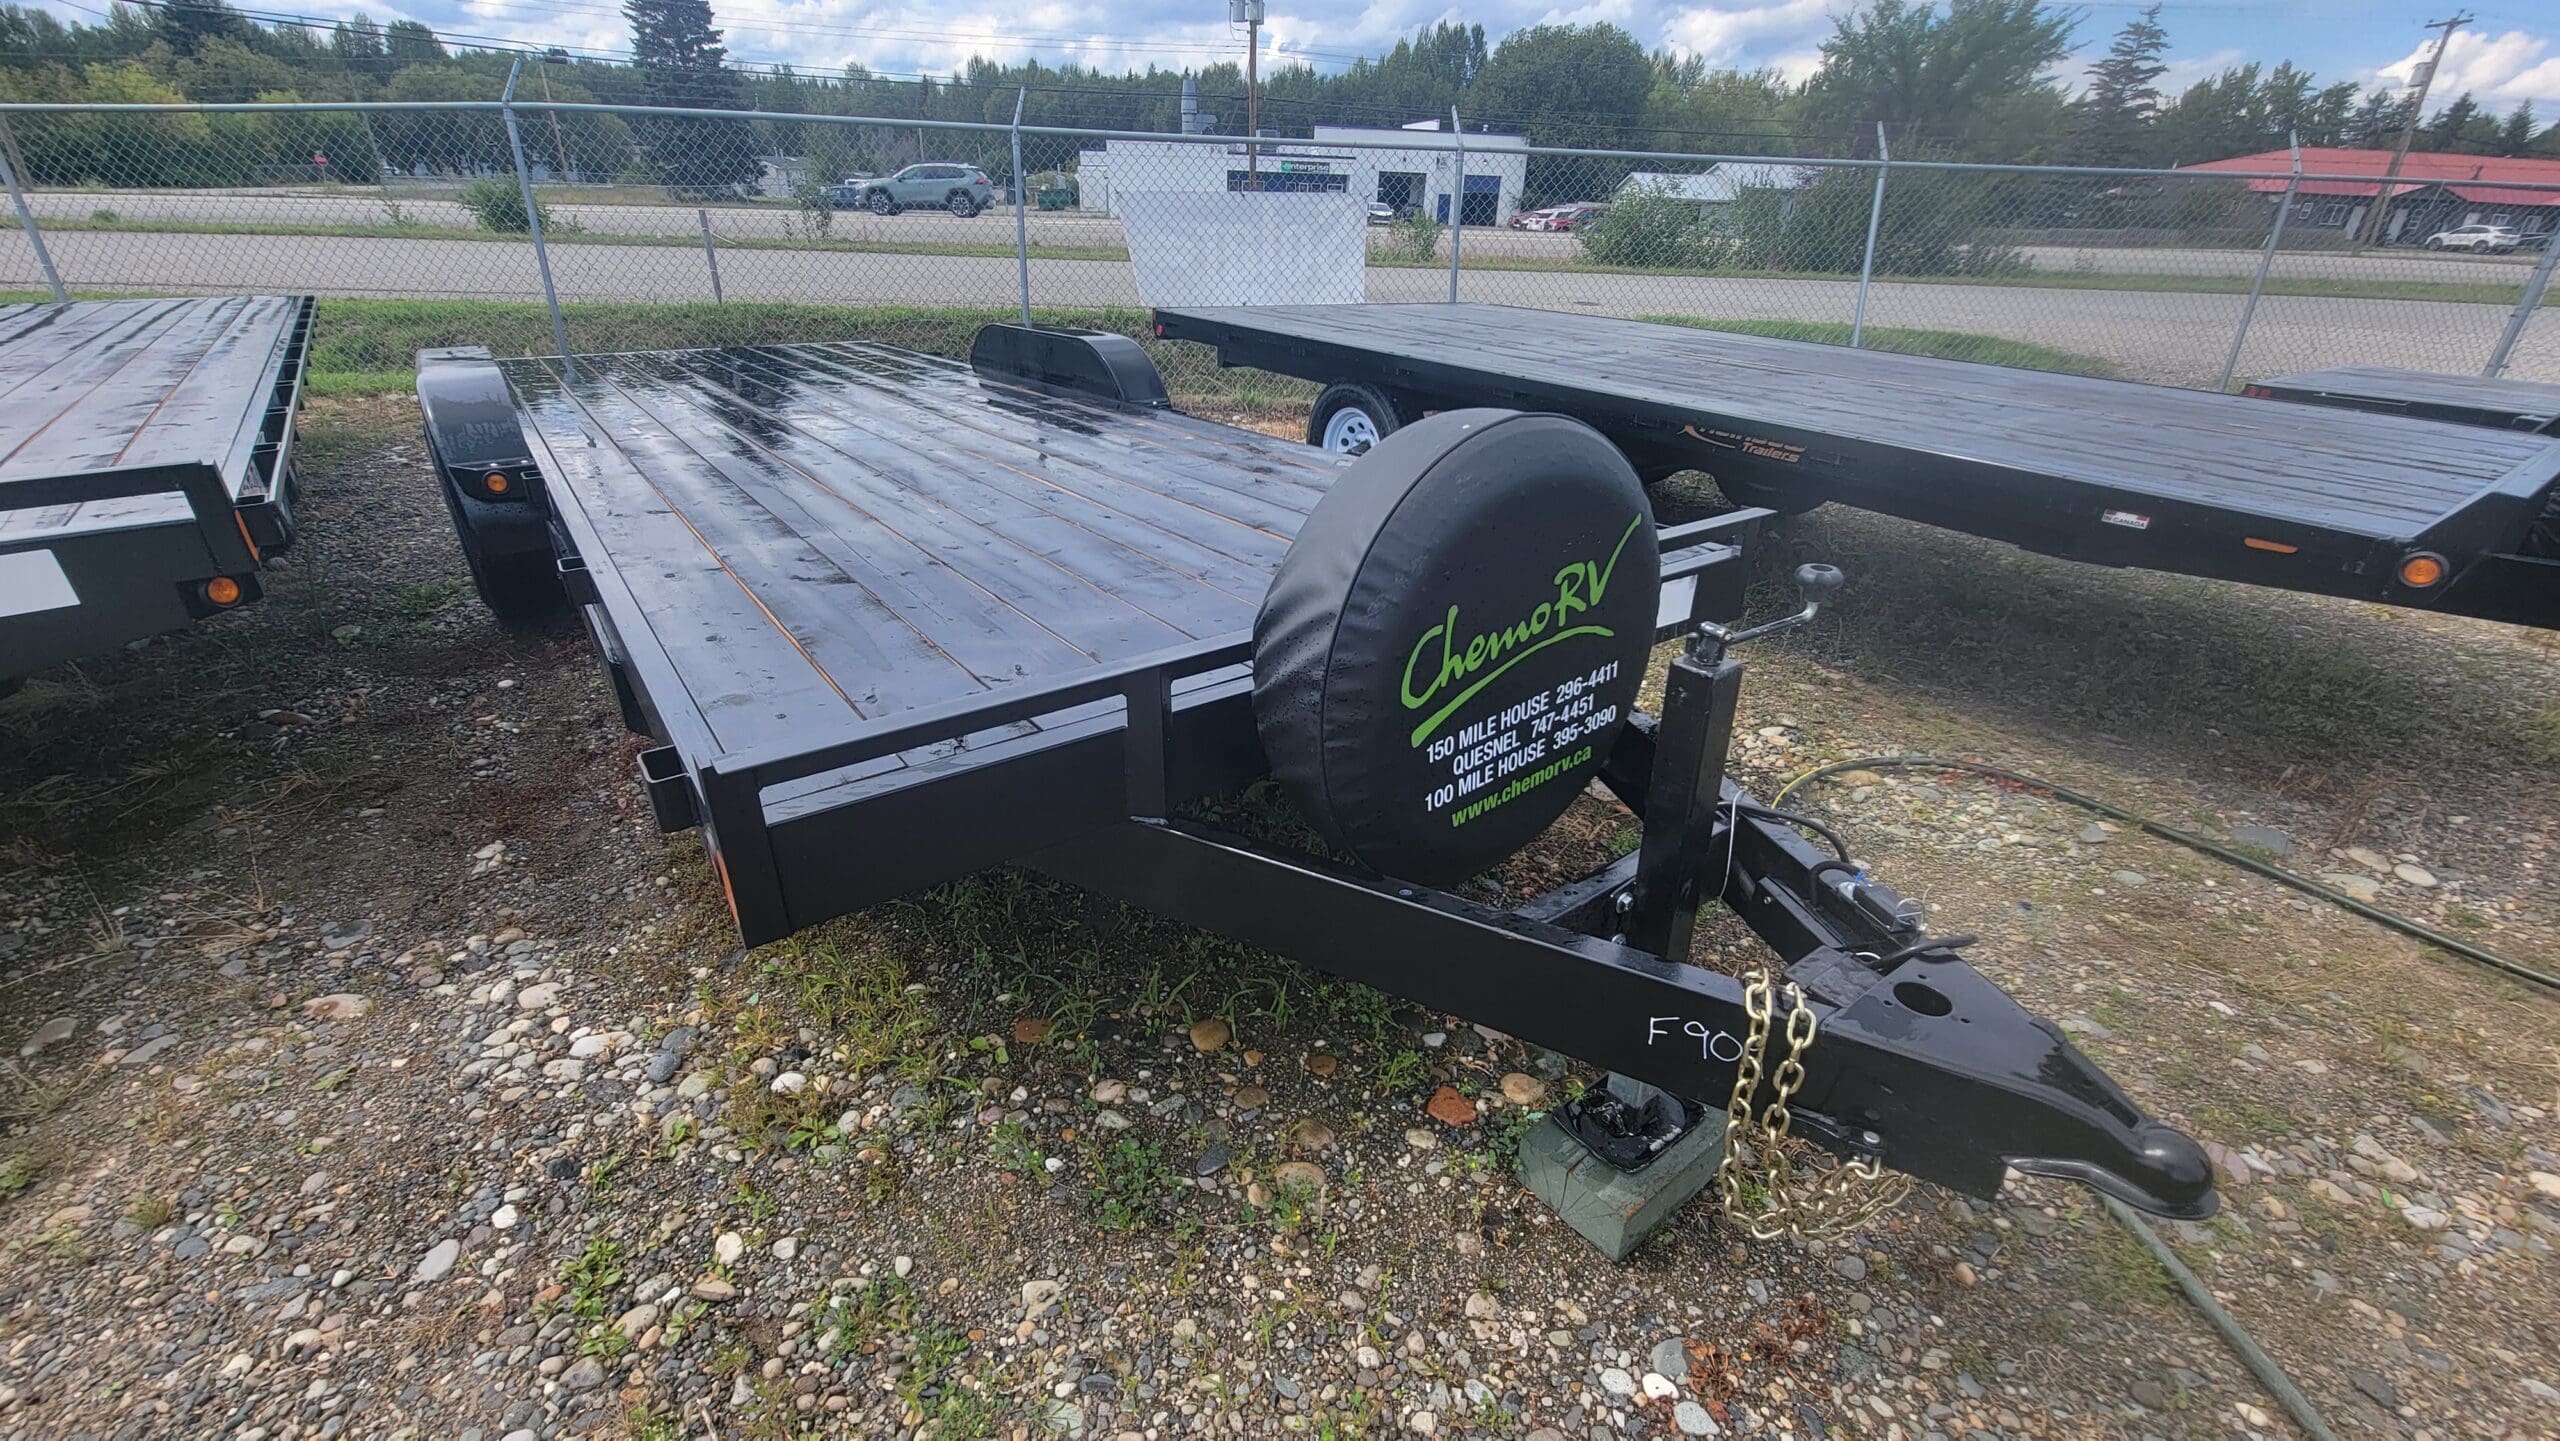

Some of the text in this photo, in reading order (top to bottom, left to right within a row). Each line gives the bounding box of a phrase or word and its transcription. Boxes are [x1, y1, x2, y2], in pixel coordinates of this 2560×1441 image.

[1743, 442, 1800, 463] Trailers
[1426, 660, 1619, 764] 150 MILE HOUSE 296-4411
[1452, 693, 1595, 776] QUESNEL 747-4451
[1424, 704, 1617, 812] 100 MILE HOUSE 395-3090
[1451, 745, 1592, 828] www.chemorv.ca
